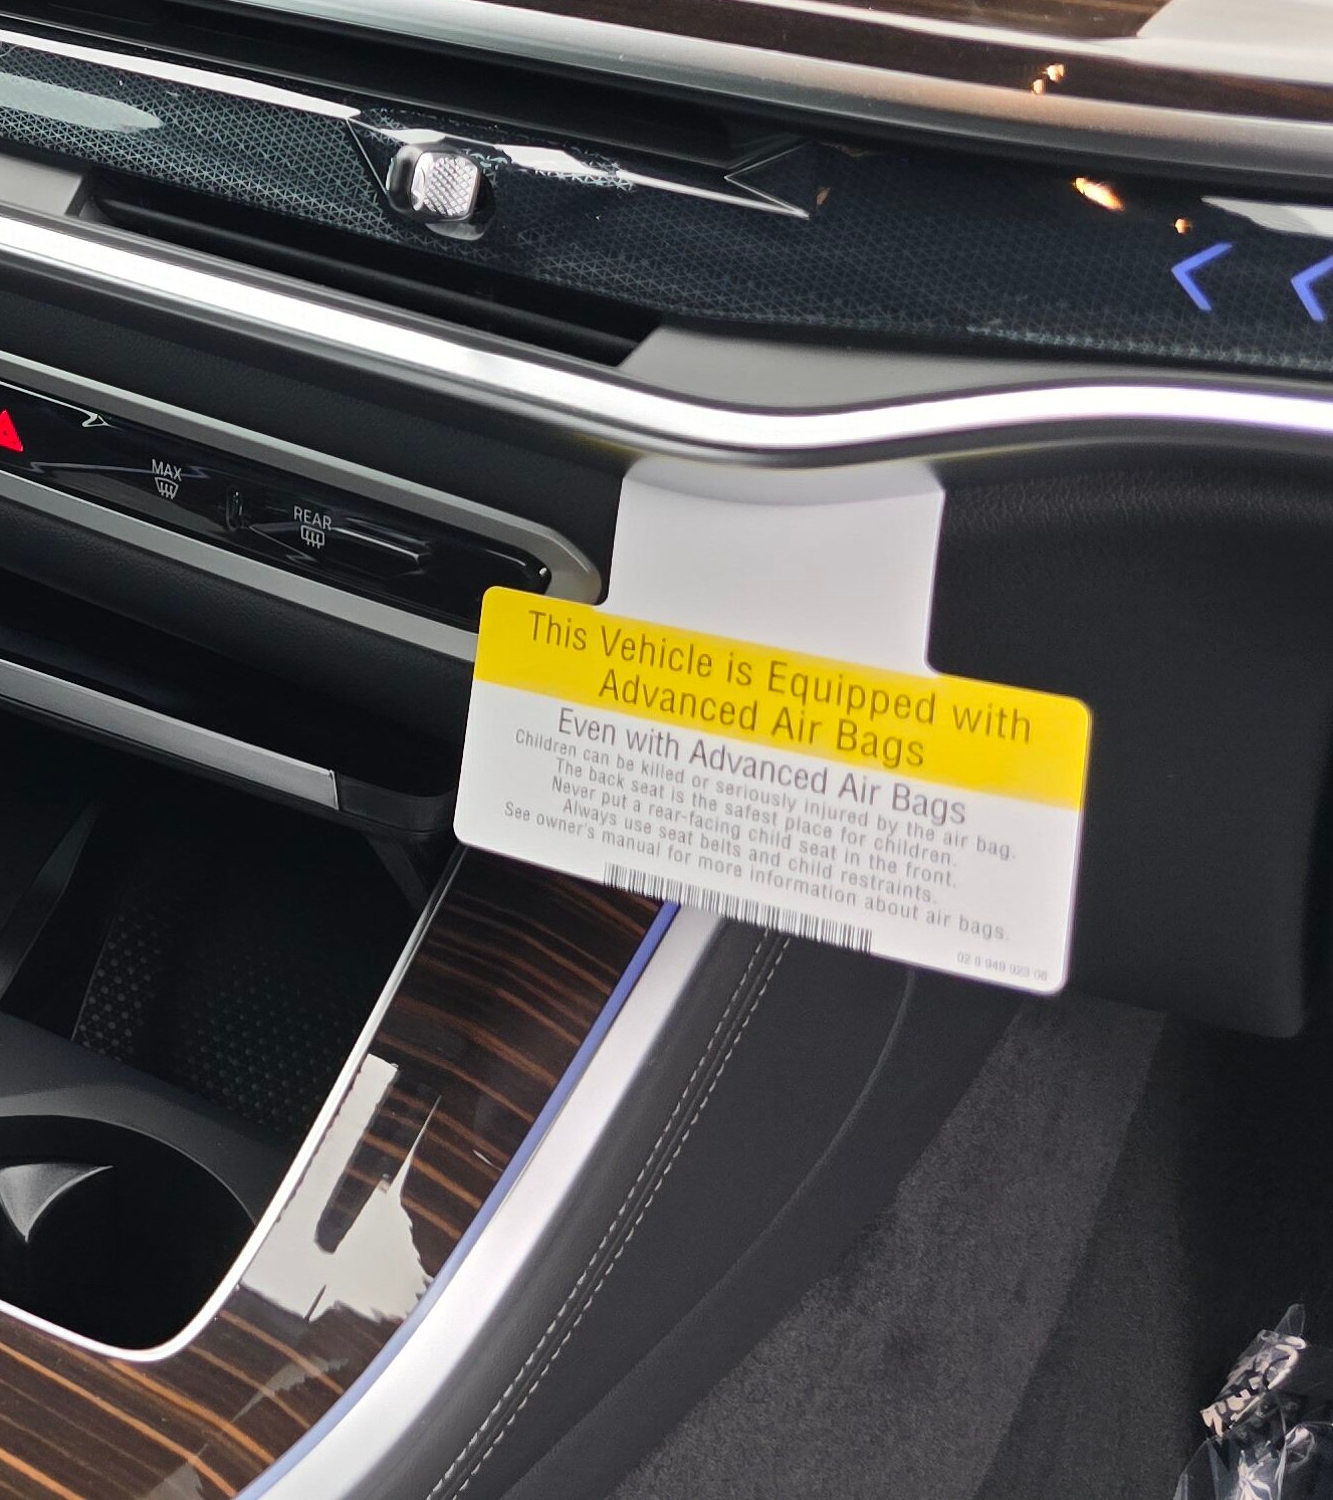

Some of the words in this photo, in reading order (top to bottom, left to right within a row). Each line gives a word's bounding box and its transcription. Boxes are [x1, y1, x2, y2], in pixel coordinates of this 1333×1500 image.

[151, 458, 183, 482] MAX
[293, 505, 333, 530] REAR
[528, 609, 588, 651] This
[600, 624, 713, 678] Vehicle
[727, 651, 753, 687] is
[767, 659, 936, 726] Equipped
[952, 701, 1032, 745] with
[598, 668, 759, 732] Advanced
[770, 705, 823, 745] Air
[836, 718, 925, 769] Bags
[515, 727, 578, 758] Children
[582, 747, 611, 768] can
[616, 754, 635, 772] be
[641, 760, 686, 785] killed
[691, 774, 710, 789] or
[715, 780, 798, 813] seriously
[804, 797, 869, 828] injured
[877, 814, 899, 837] by
[906, 821, 935, 842] the
[943, 829, 969, 849] air
[976, 835, 1017, 862] bag.
[555, 757, 583, 778] The
[589, 766, 625, 790] back
[632, 778, 665, 799] seat
[671, 784, 685, 804] is
[692, 790, 718, 812] the
[725, 800, 778, 827] safest
[785, 812, 833, 839] place
[840, 826, 867, 847] for
[874, 835, 957, 868] children.
[558, 706, 616, 746] Even
[626, 727, 680, 761] with
[688, 738, 829, 795] Advanced
[837, 771, 882, 806] Air
[891, 782, 967, 827] Bags
[504, 800, 531, 822] See
[536, 812, 595, 840] owner's
[602, 830, 661, 857] manual
[668, 844, 693, 865] for
[698, 855, 743, 878] more
[750, 865, 857, 907] information
[865, 895, 919, 922] about
[926, 907, 952, 928] air
[958, 913, 1011, 942] bags.
[551, 775, 596, 800] Never
[602, 789, 627, 810] put
[632, 799, 641, 813] a
[648, 801, 741, 841] rear-facing
[748, 825, 792, 850] child
[799, 839, 837, 861] seat
[844, 848, 861, 866] in
[869, 852, 898, 875] the
[905, 859, 957, 888] front.
[562, 798, 618, 829] Always
[624, 816, 652, 835] use
[659, 824, 694, 846] seat
[700, 832, 742, 857] belts
[748, 847, 781, 868] and
[788, 855, 833, 880] child
[841, 868, 937, 905] restraints.
